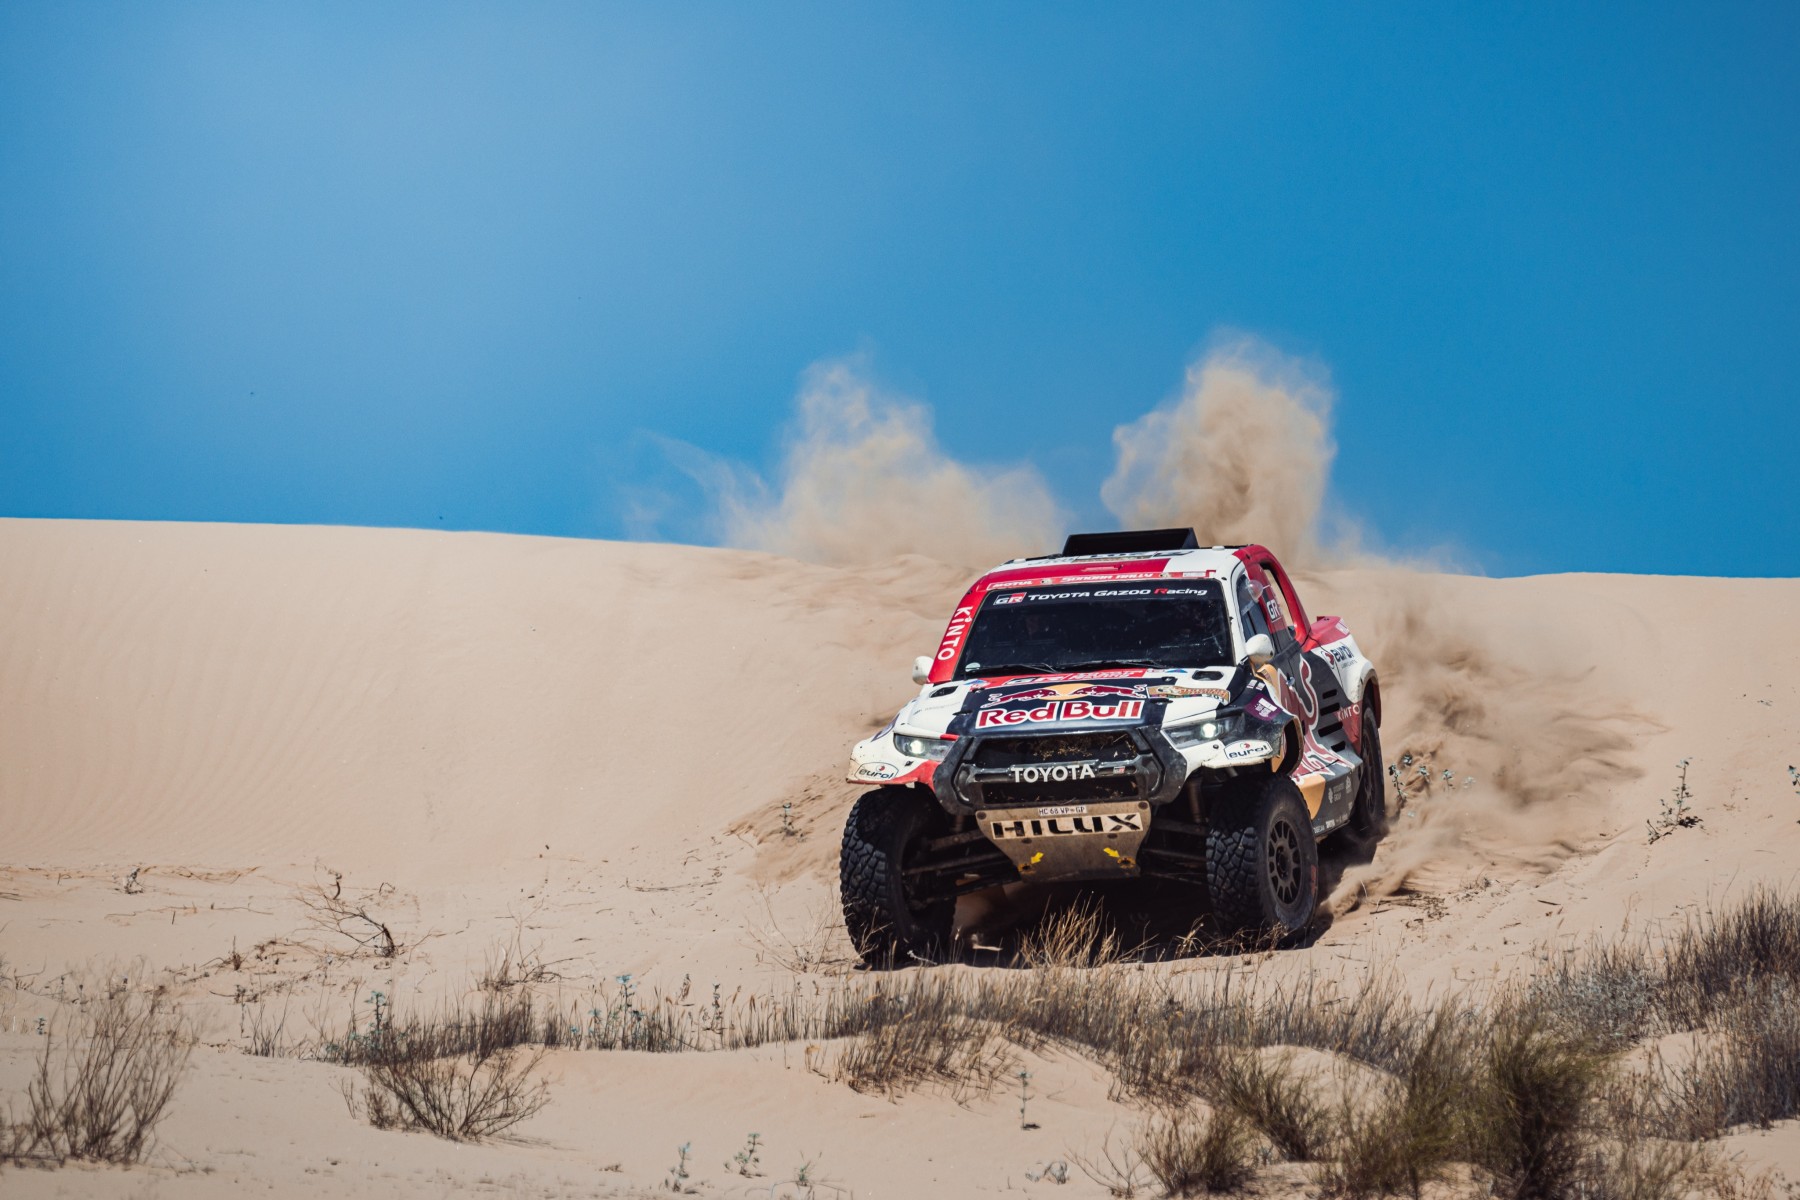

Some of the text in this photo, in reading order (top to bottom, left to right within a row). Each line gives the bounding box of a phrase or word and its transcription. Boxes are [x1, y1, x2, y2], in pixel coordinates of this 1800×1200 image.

[994, 587, 1208, 605] GR TOYOTA GAZOO Racing
[976, 700, 1144, 729] Red Bull
[1228, 744, 1269, 759] eurol
[858, 768, 893, 779] eurol
[1010, 764, 1096, 783] TOYOTA
[993, 814, 1141, 838] HILUX
